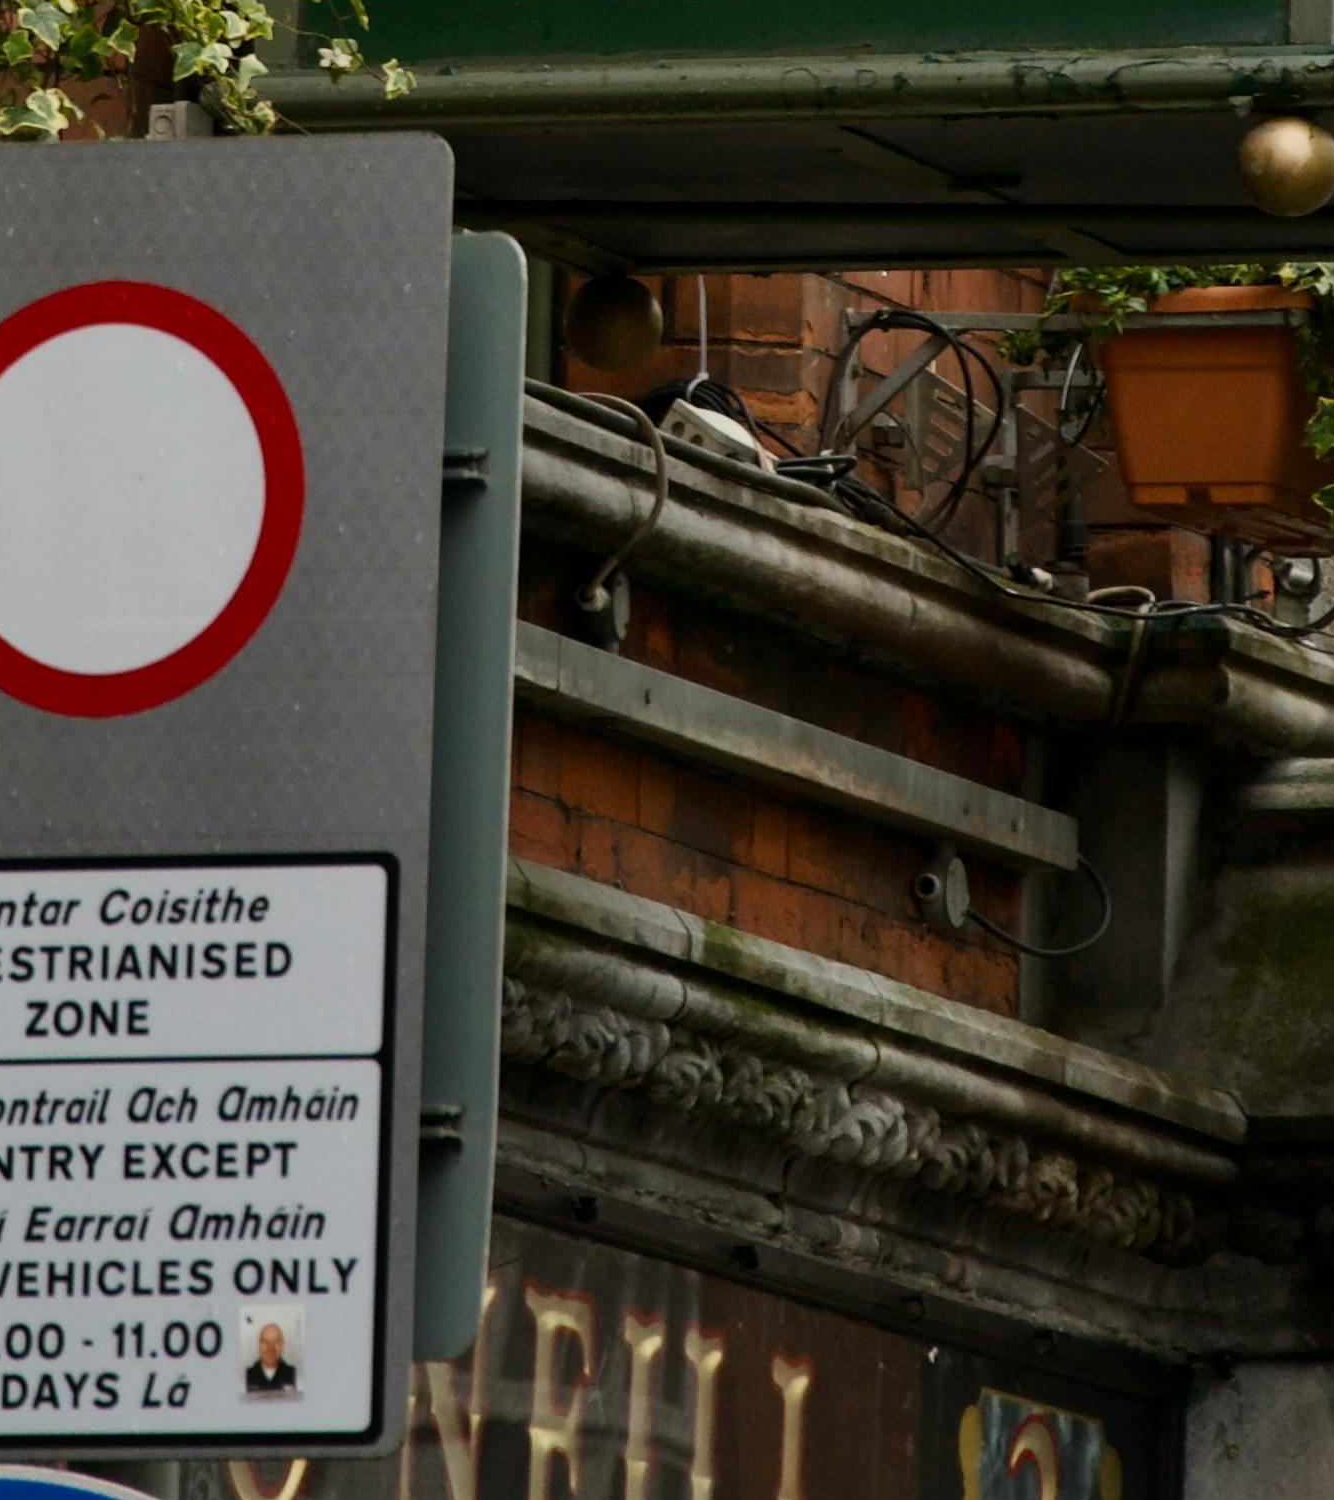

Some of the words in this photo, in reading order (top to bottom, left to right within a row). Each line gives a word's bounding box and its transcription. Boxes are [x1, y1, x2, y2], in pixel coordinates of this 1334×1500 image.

[99, 887, 270, 926] Coisithe
[24, 999, 150, 1038] ZONE
[127, 1086, 198, 1124] Ach
[217, 1084, 359, 1123] Amháin
[123, 1141, 298, 1180] EXCEPT
[23, 1205, 152, 1243] Earraí
[168, 1202, 326, 1241] Amháin
[232, 1257, 357, 1296] ONLY
[112, 1320, 223, 1360] 11.00
[0, 1371, 120, 1411] DAYS
[141, 1371, 191, 1409] Lá
